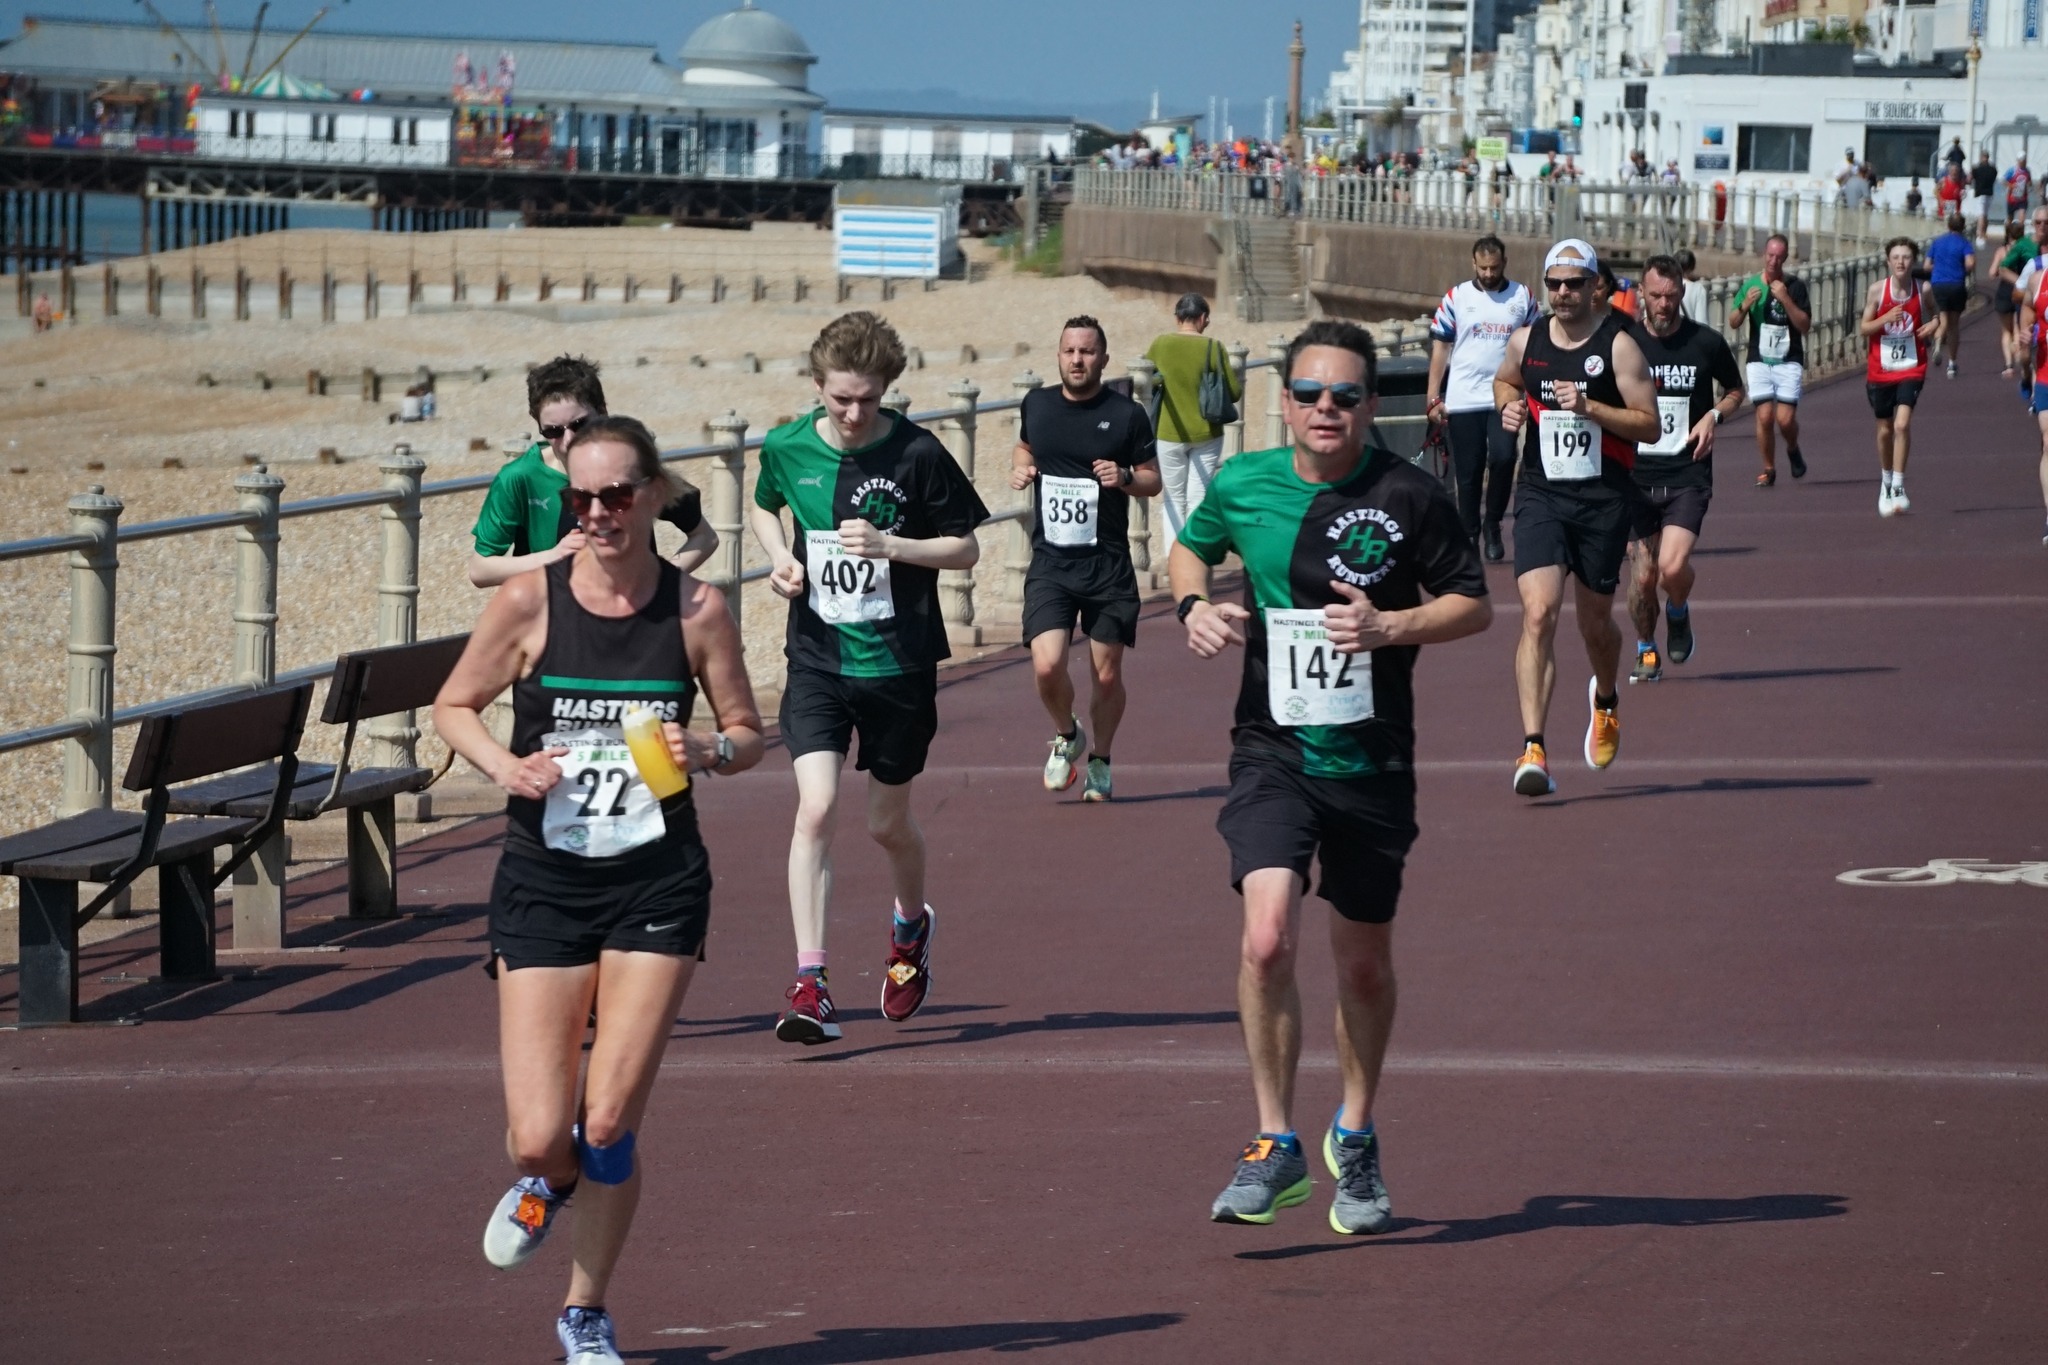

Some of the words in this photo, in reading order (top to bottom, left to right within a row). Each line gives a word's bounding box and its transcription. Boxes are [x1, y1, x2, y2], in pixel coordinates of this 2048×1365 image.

[1864, 101, 1880, 118] THE
[1883, 101, 1917, 118] SOURCE
[1920, 102, 1944, 118] PARK
[1487, 323, 1513, 334] STAR
[1769, 335, 1781, 348] 17
[1891, 345, 1907, 360] 62
[1655, 365, 1697, 377] HEART
[1664, 376, 1696, 388] SOLE
[1554, 430, 1592, 457] 199
[851, 478, 907, 506] HASTINGS
[1049, 496, 1088, 524] 358
[1325, 508, 1404, 542] HASTINGS
[821, 559, 876, 595] 402
[1326, 554, 1397, 586] RUNNERS
[1273, 619, 1316, 627] HASTINGS
[1293, 630, 1299, 639] 5
[1304, 630, 1328, 640] MIL
[1289, 645, 1354, 690] 142
[578, 751, 584, 761] 5
[590, 750, 628, 762] MILE
[576, 767, 630, 817] 22
